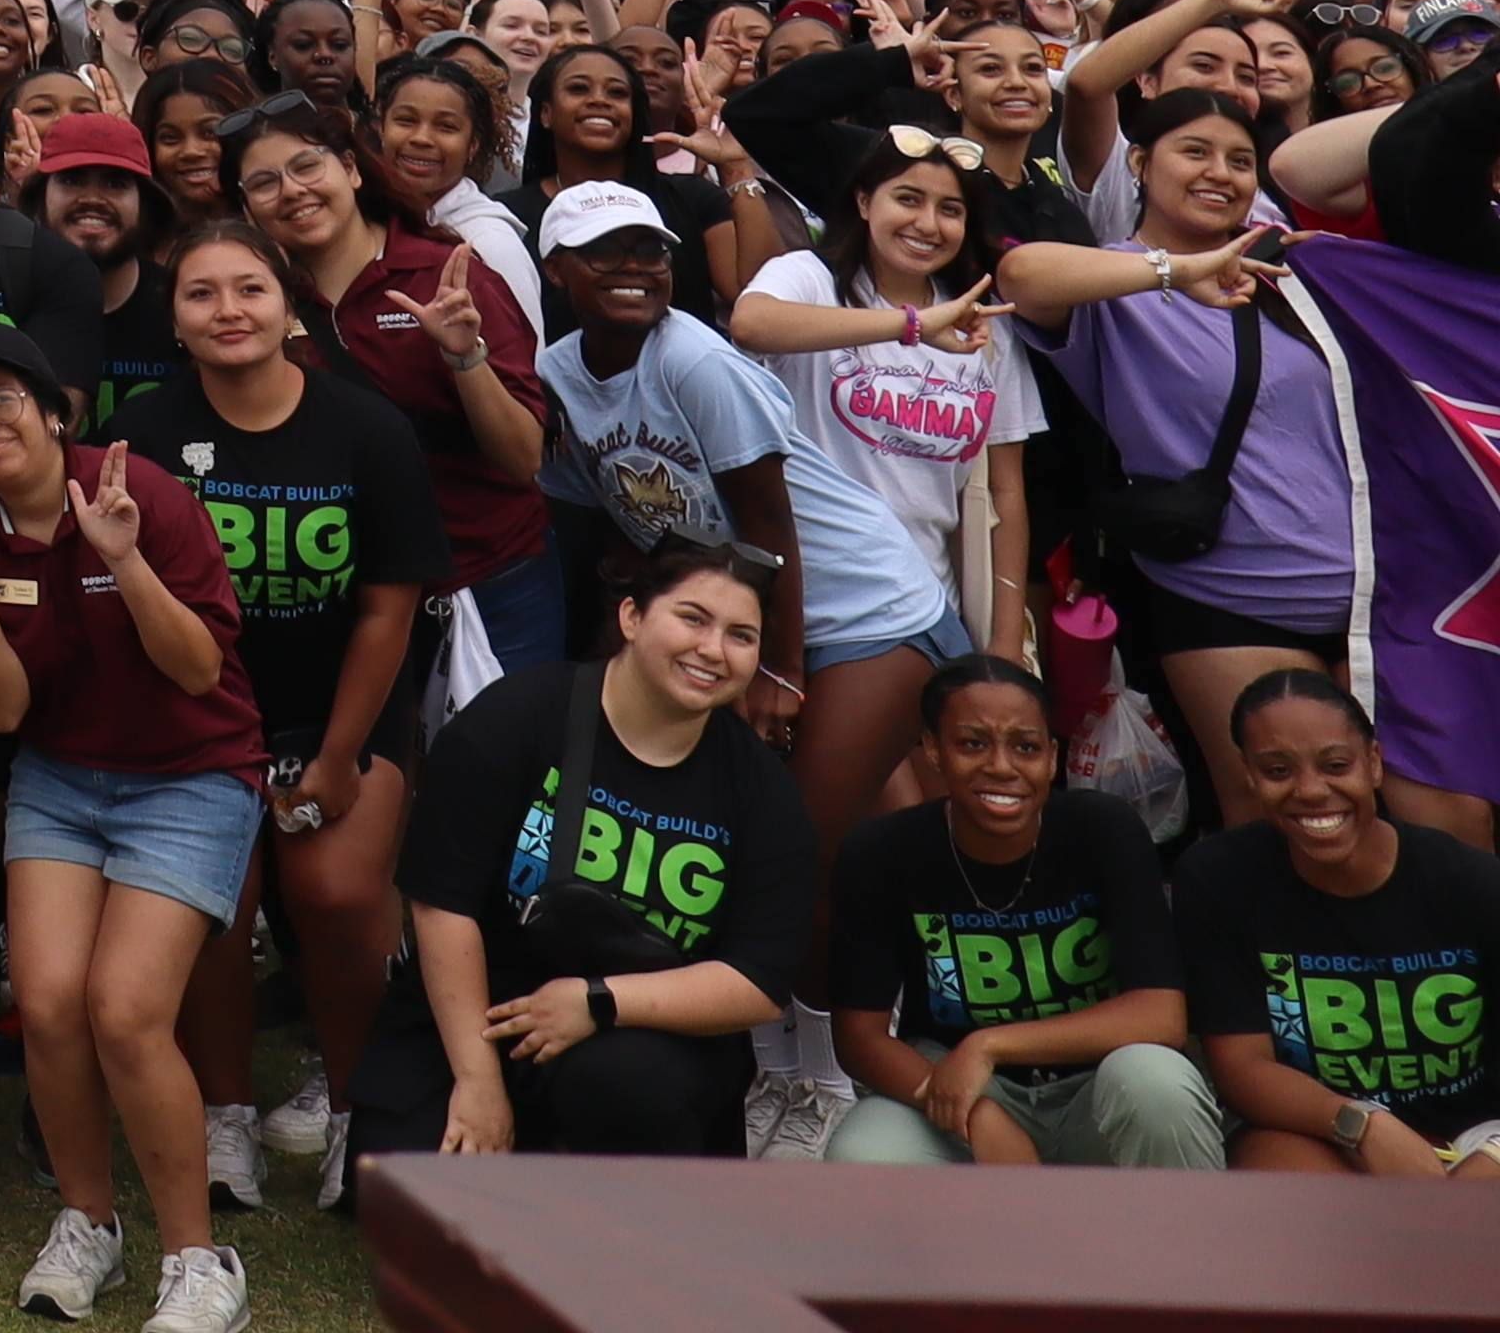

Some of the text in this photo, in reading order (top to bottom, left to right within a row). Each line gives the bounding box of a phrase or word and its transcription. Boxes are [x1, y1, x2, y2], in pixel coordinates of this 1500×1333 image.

[849, 384, 976, 442] GAMMA
[635, 420, 703, 473] Build
[205, 480, 282, 500] BOBCAT
[203, 500, 350, 572] BIG
[228, 564, 355, 605] VENT
[656, 815, 731, 846] BUILD'S
[573, 806, 726, 916] BIG
[952, 912, 1030, 930] BOBCAT
[955, 916, 1111, 1009] BIG
[1300, 948, 1479, 973] BOBCAT BUILD'S
[1301, 973, 1484, 1051] BIG
[1314, 1036, 1483, 1091] EVENT
